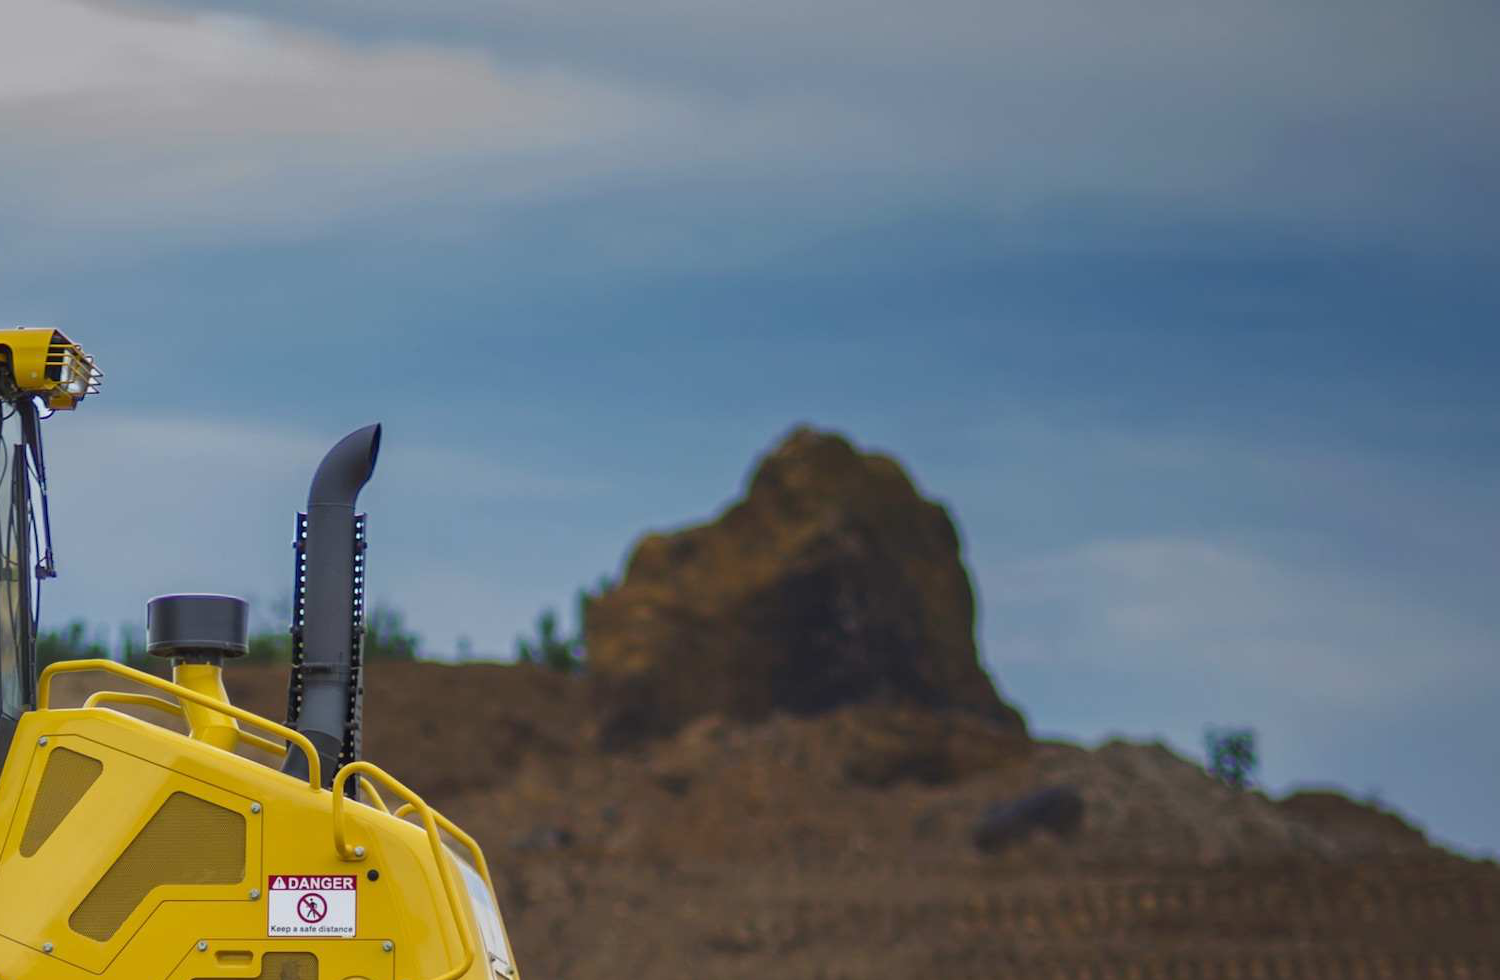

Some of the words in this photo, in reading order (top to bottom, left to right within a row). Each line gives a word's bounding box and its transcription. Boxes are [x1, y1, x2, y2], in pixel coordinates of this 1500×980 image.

[288, 877, 354, 889] DANGER
[271, 925, 291, 933] Keep
[318, 925, 353, 933] distance
